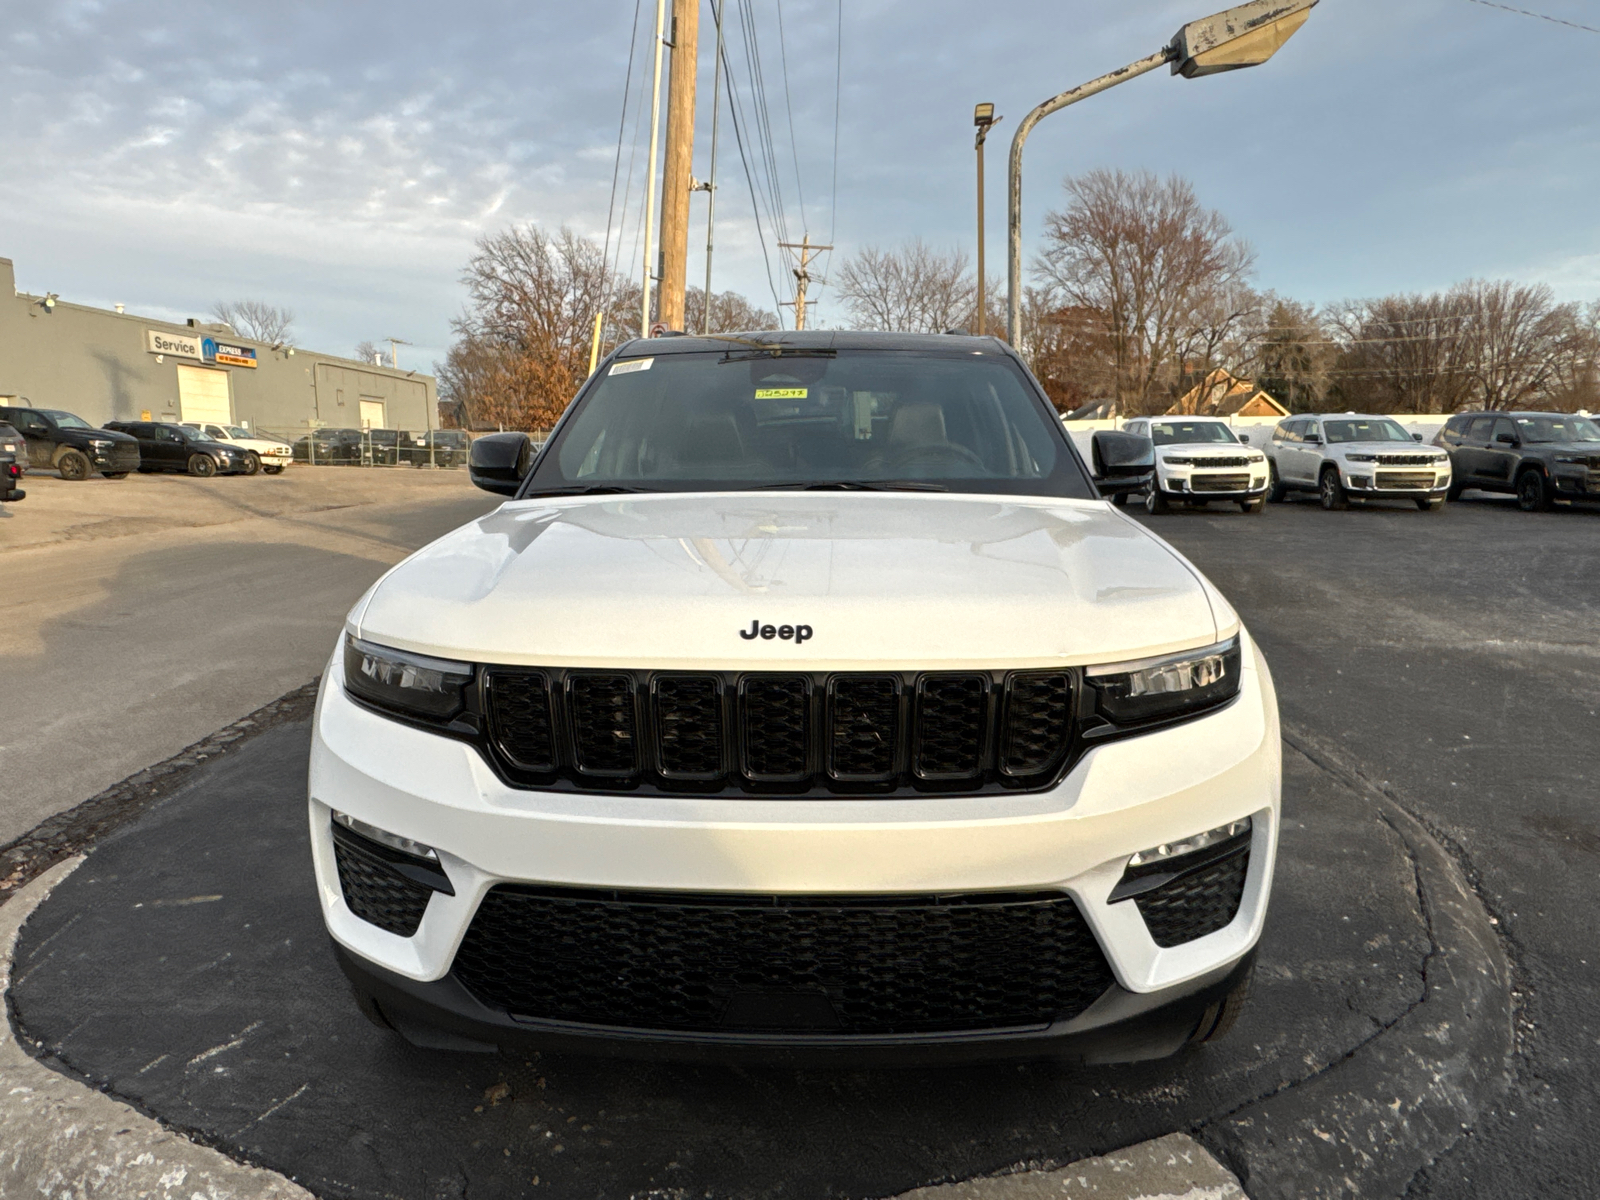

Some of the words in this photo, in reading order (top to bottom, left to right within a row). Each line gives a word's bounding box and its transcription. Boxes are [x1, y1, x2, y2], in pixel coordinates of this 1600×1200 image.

[155, 336, 195, 354] Service
[219, 345, 242, 356] EXPRESS
[740, 620, 813, 644] Jeep
